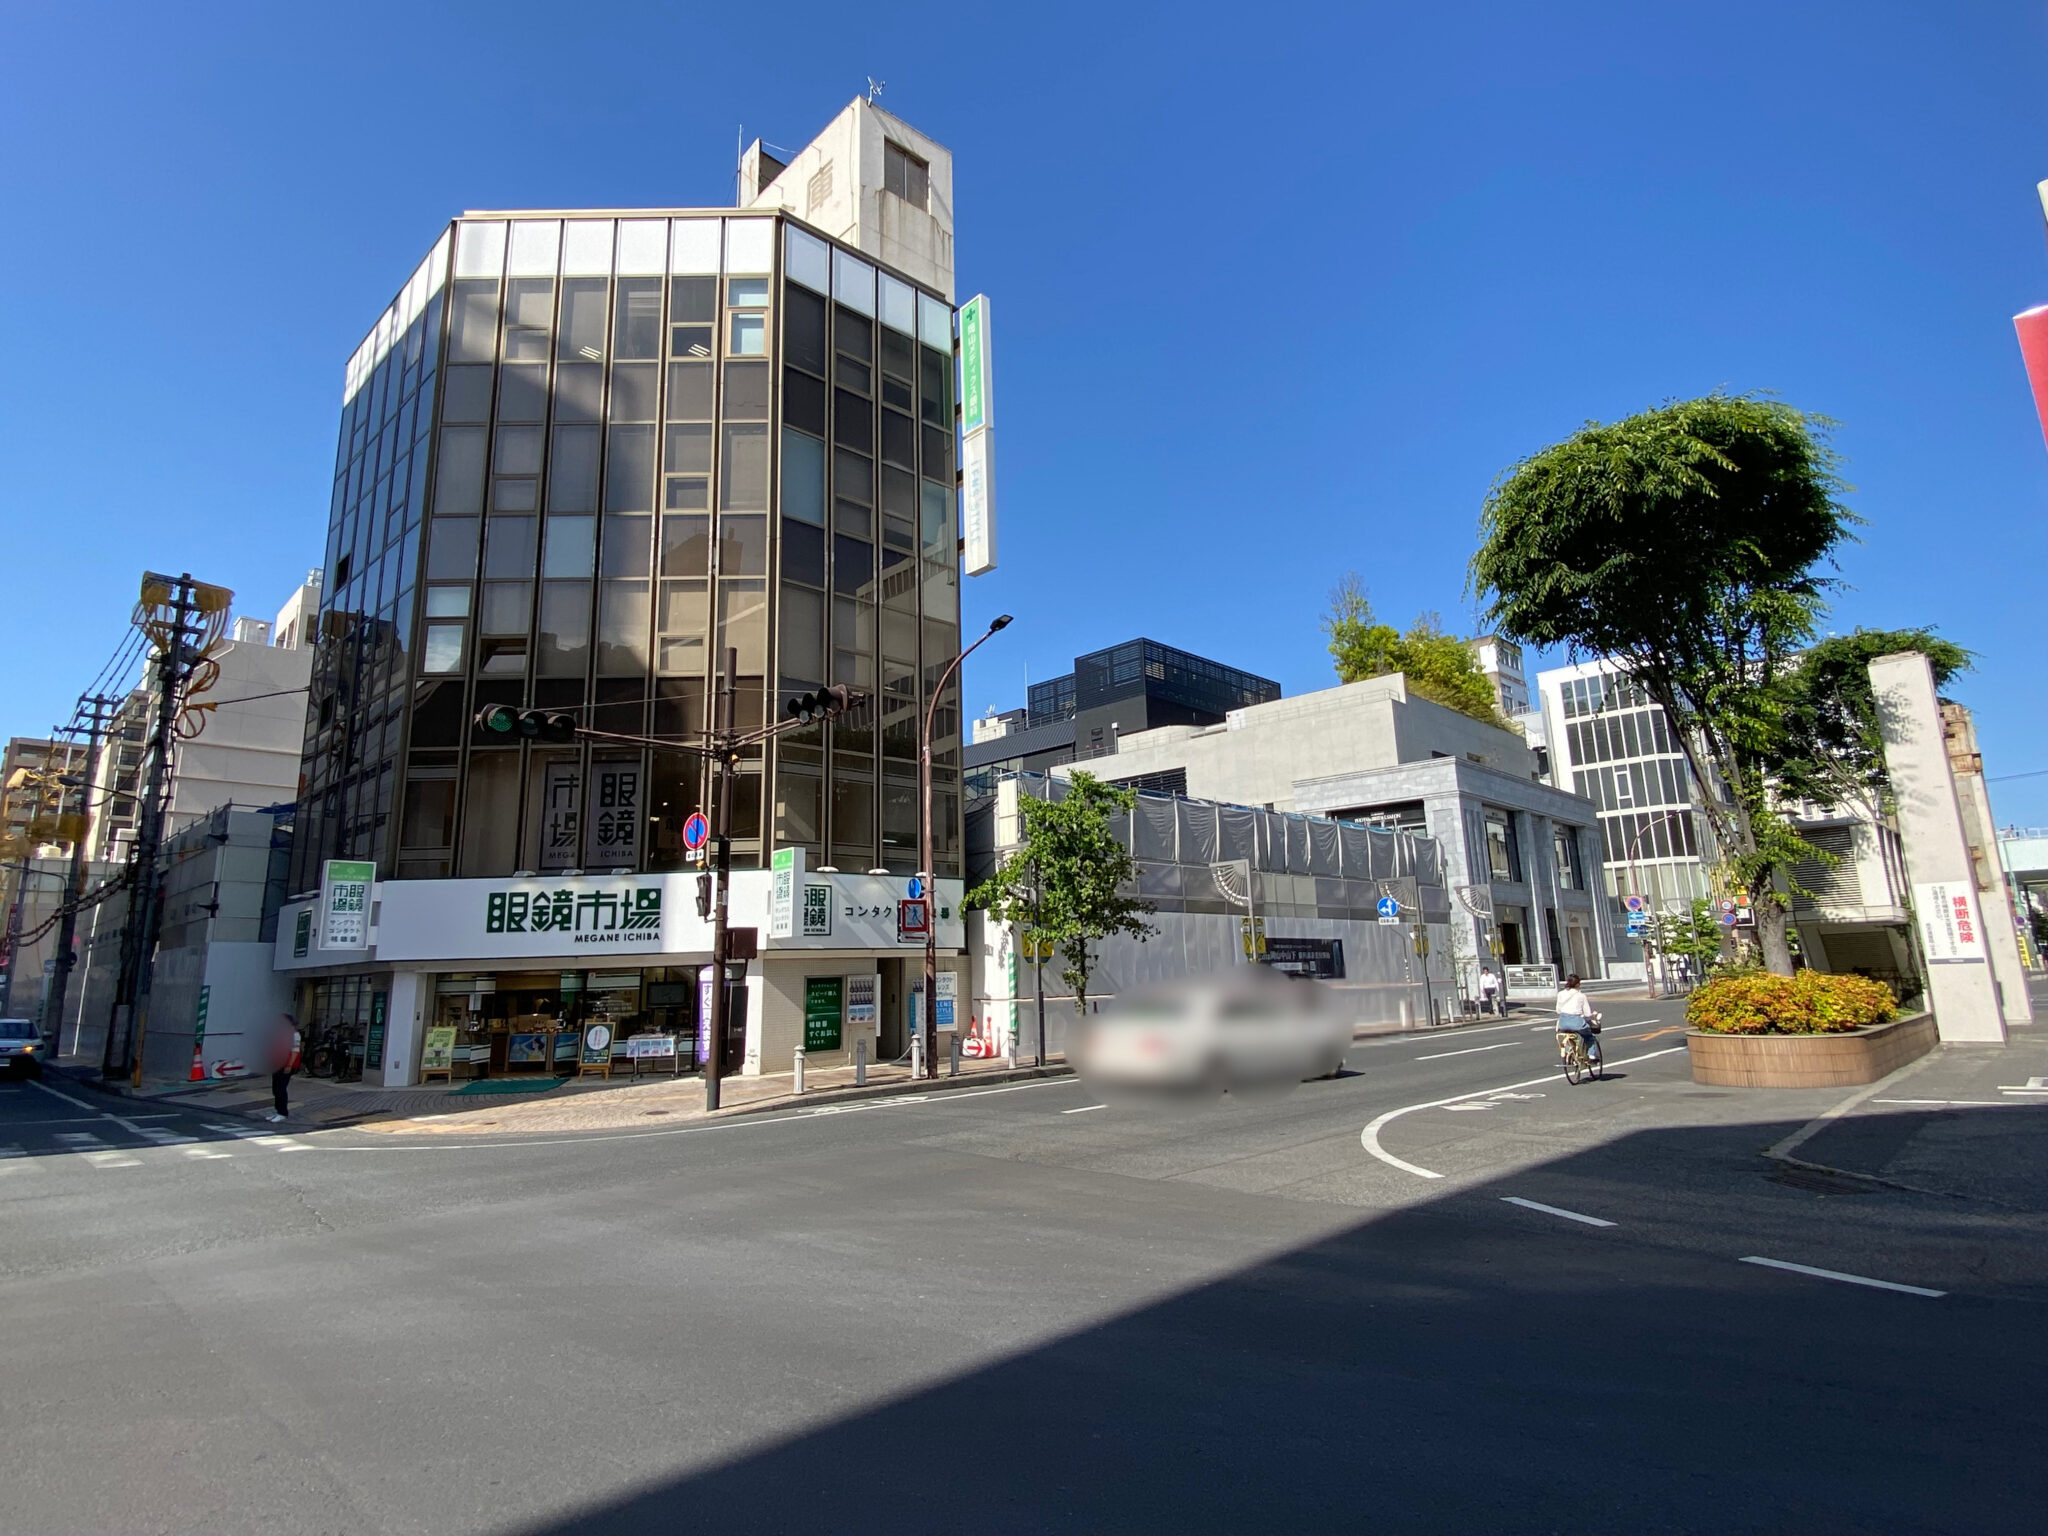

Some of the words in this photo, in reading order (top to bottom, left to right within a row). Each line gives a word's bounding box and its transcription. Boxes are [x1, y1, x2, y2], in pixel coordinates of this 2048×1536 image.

[598, 773, 637, 845] 眼鏡
[600, 850, 633, 858] ICHIBA
[487, 888, 662, 933] 眼鏡市場
[845, 906, 893, 918] コンタク
[1953, 896, 1975, 943] 横断危険
[574, 935, 620, 943] MEGANE
[623, 933, 660, 941] ICHIBA
